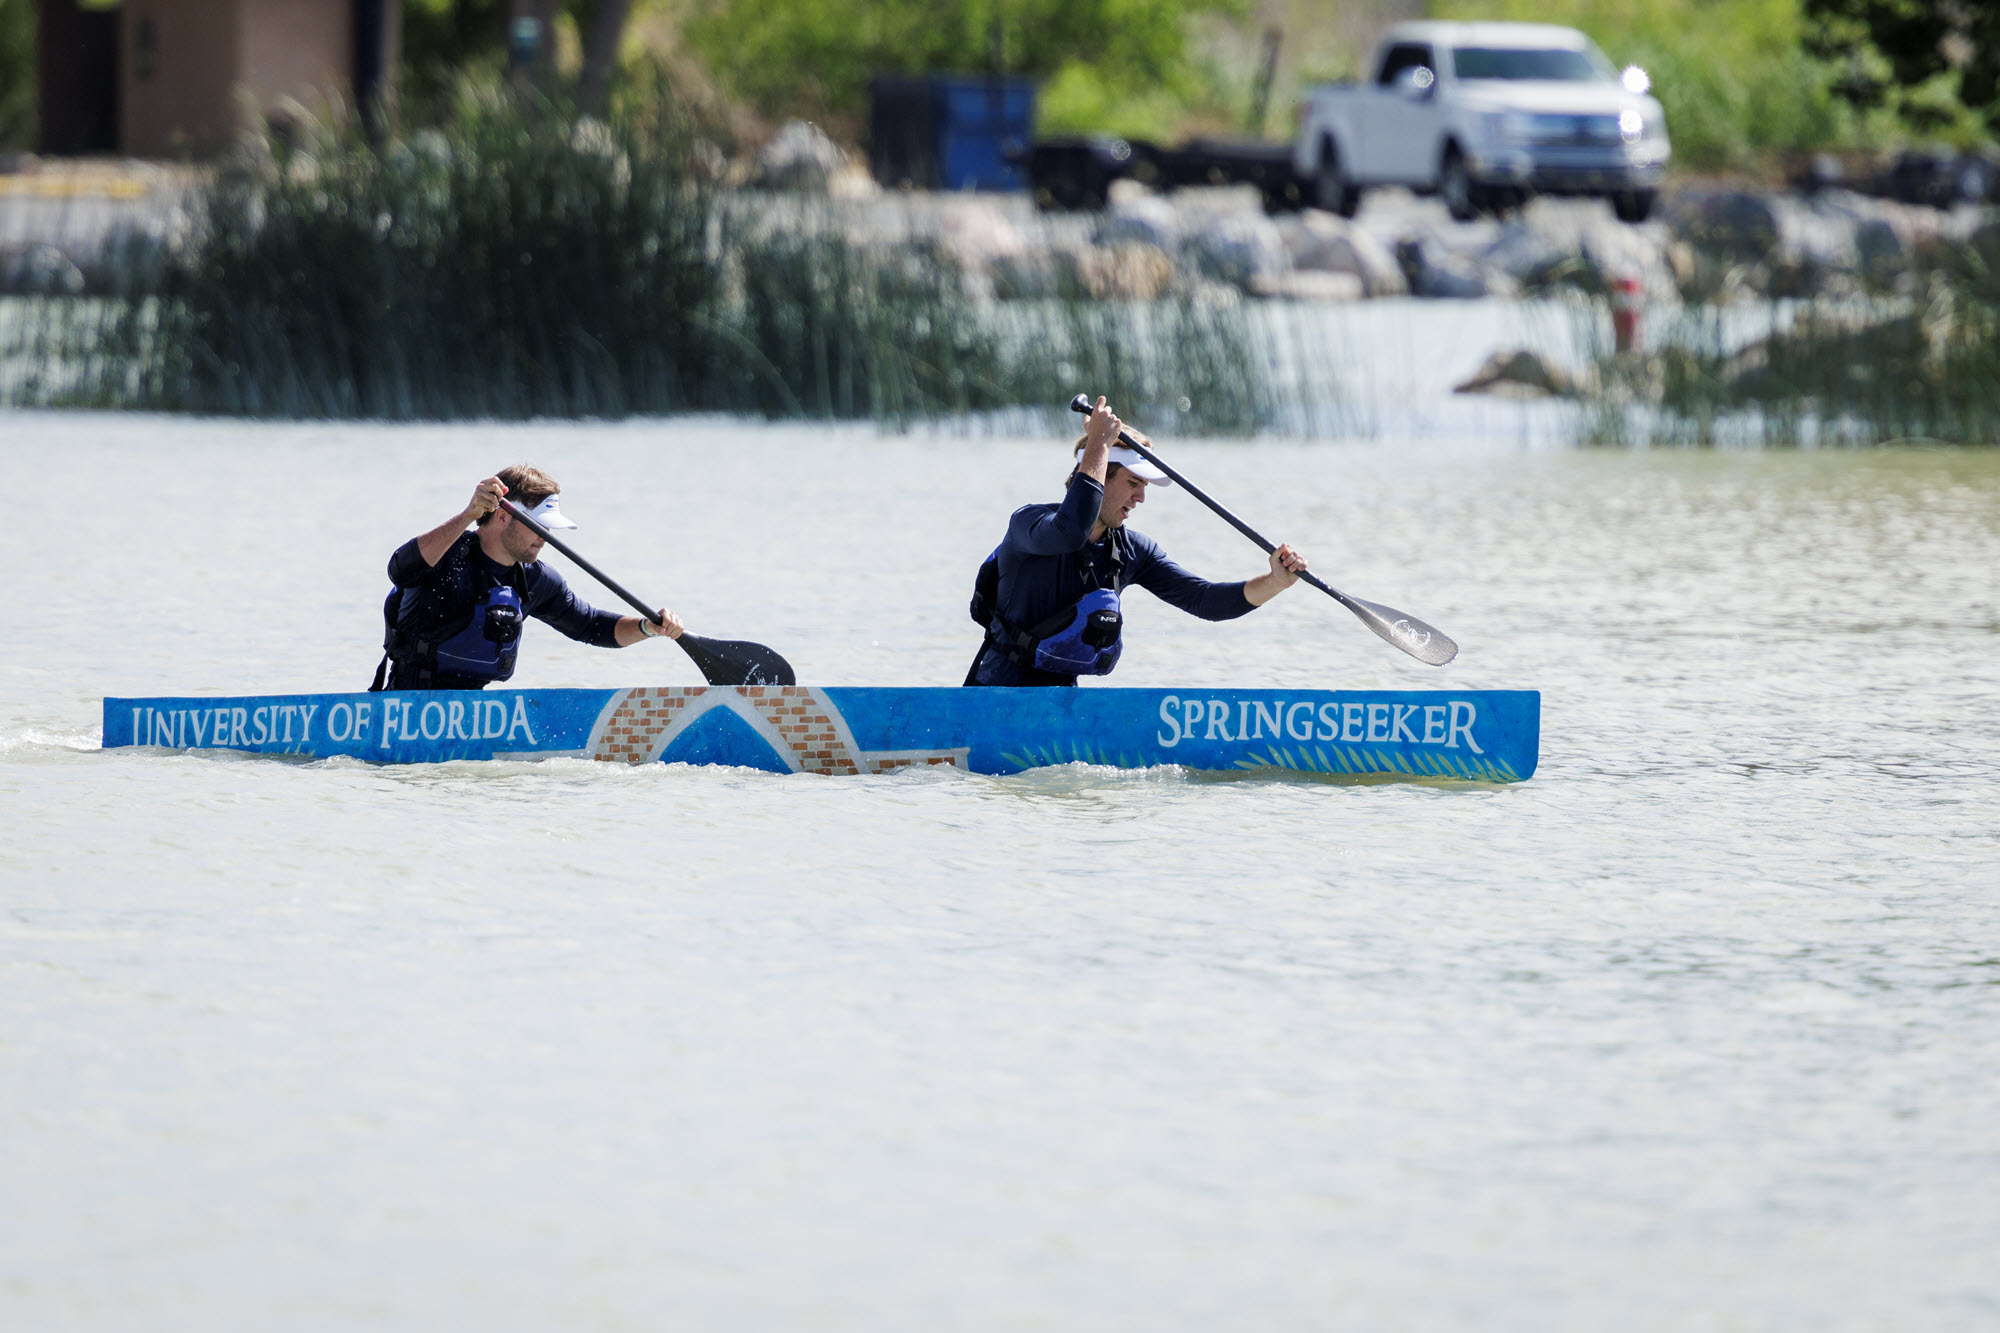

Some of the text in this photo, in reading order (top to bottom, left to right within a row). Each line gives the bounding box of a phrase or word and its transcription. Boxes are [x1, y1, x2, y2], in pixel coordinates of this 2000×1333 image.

[1100, 615, 1118, 623] NRS
[132, 695, 538, 749] UNIVERSITY OF FLORIDA
[1157, 695, 1485, 755] SPRINGSEEKER
